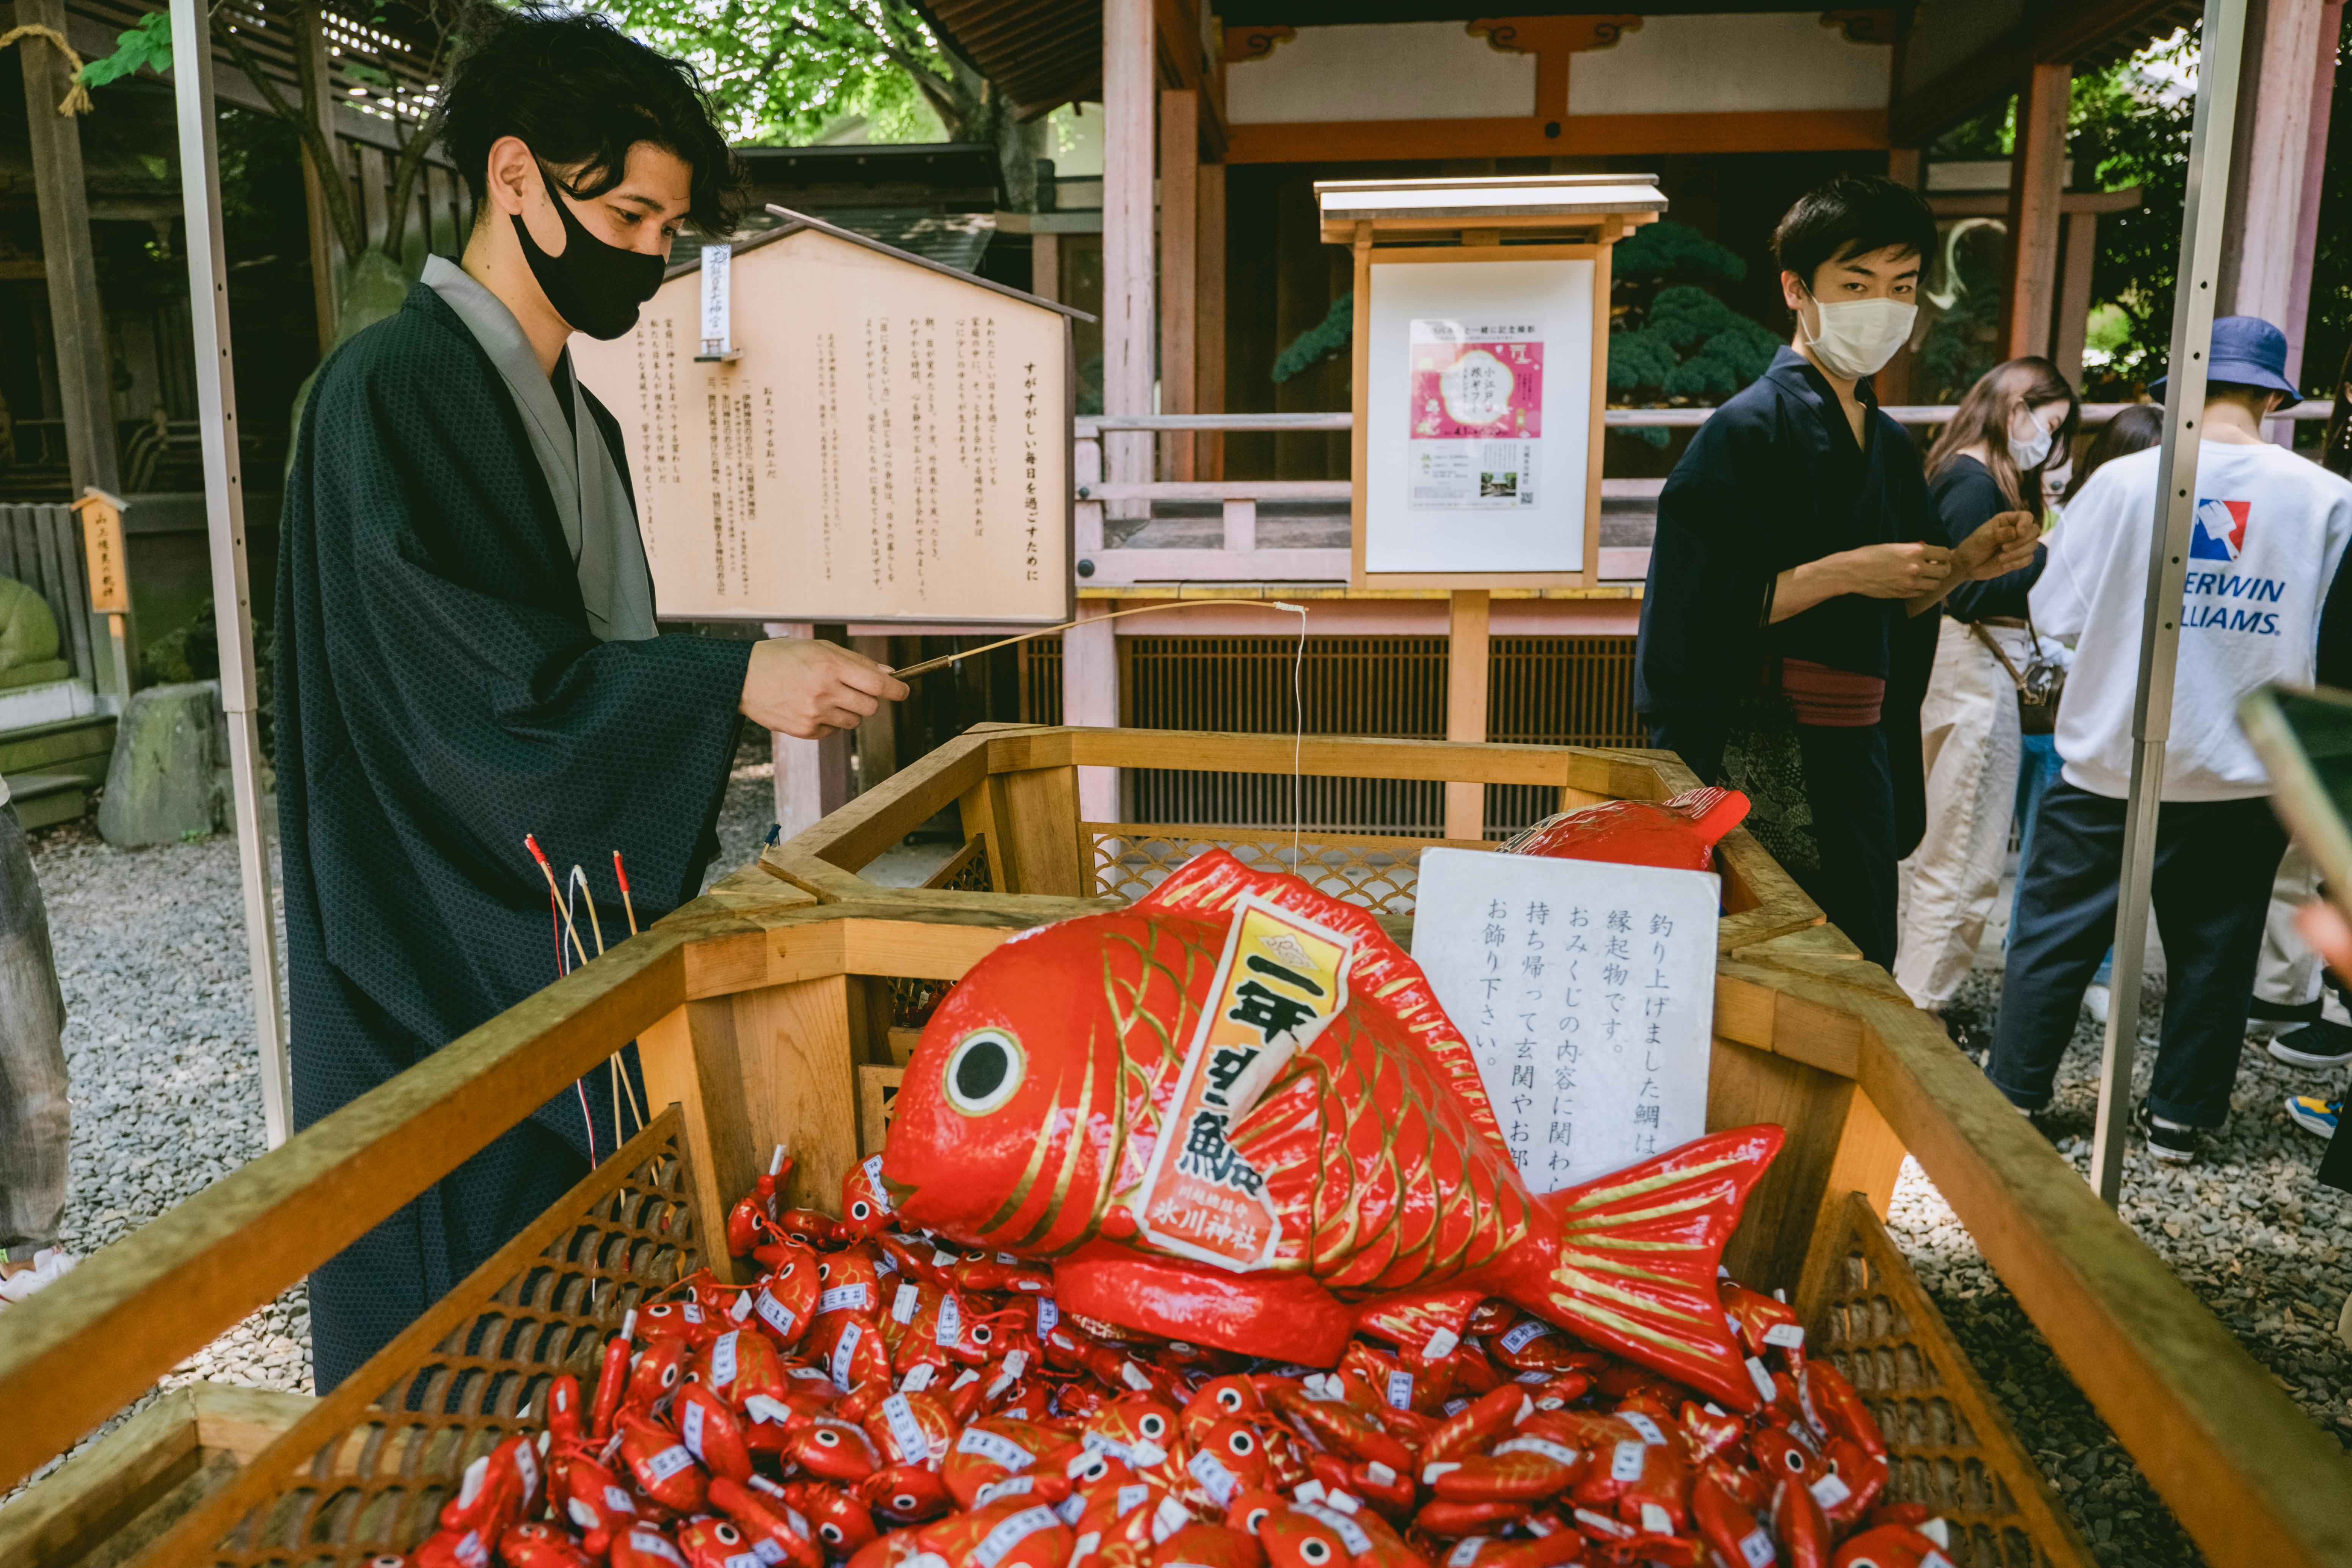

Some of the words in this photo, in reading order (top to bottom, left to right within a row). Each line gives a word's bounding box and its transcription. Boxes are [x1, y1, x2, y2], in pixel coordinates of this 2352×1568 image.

[763, 387, 776, 479] おまつりするおふだ
[1024, 362, 1038, 581] すがすがしい毎日を過ごすために
[1476, 898, 1507, 1066] お飾り下さい。
[1601, 909, 1633, 1054] 縁起物です。
[1634, 913, 1674, 1155] 釣り上げました鯛は
[1152, 1198, 1256, 1252] 氷川神社
